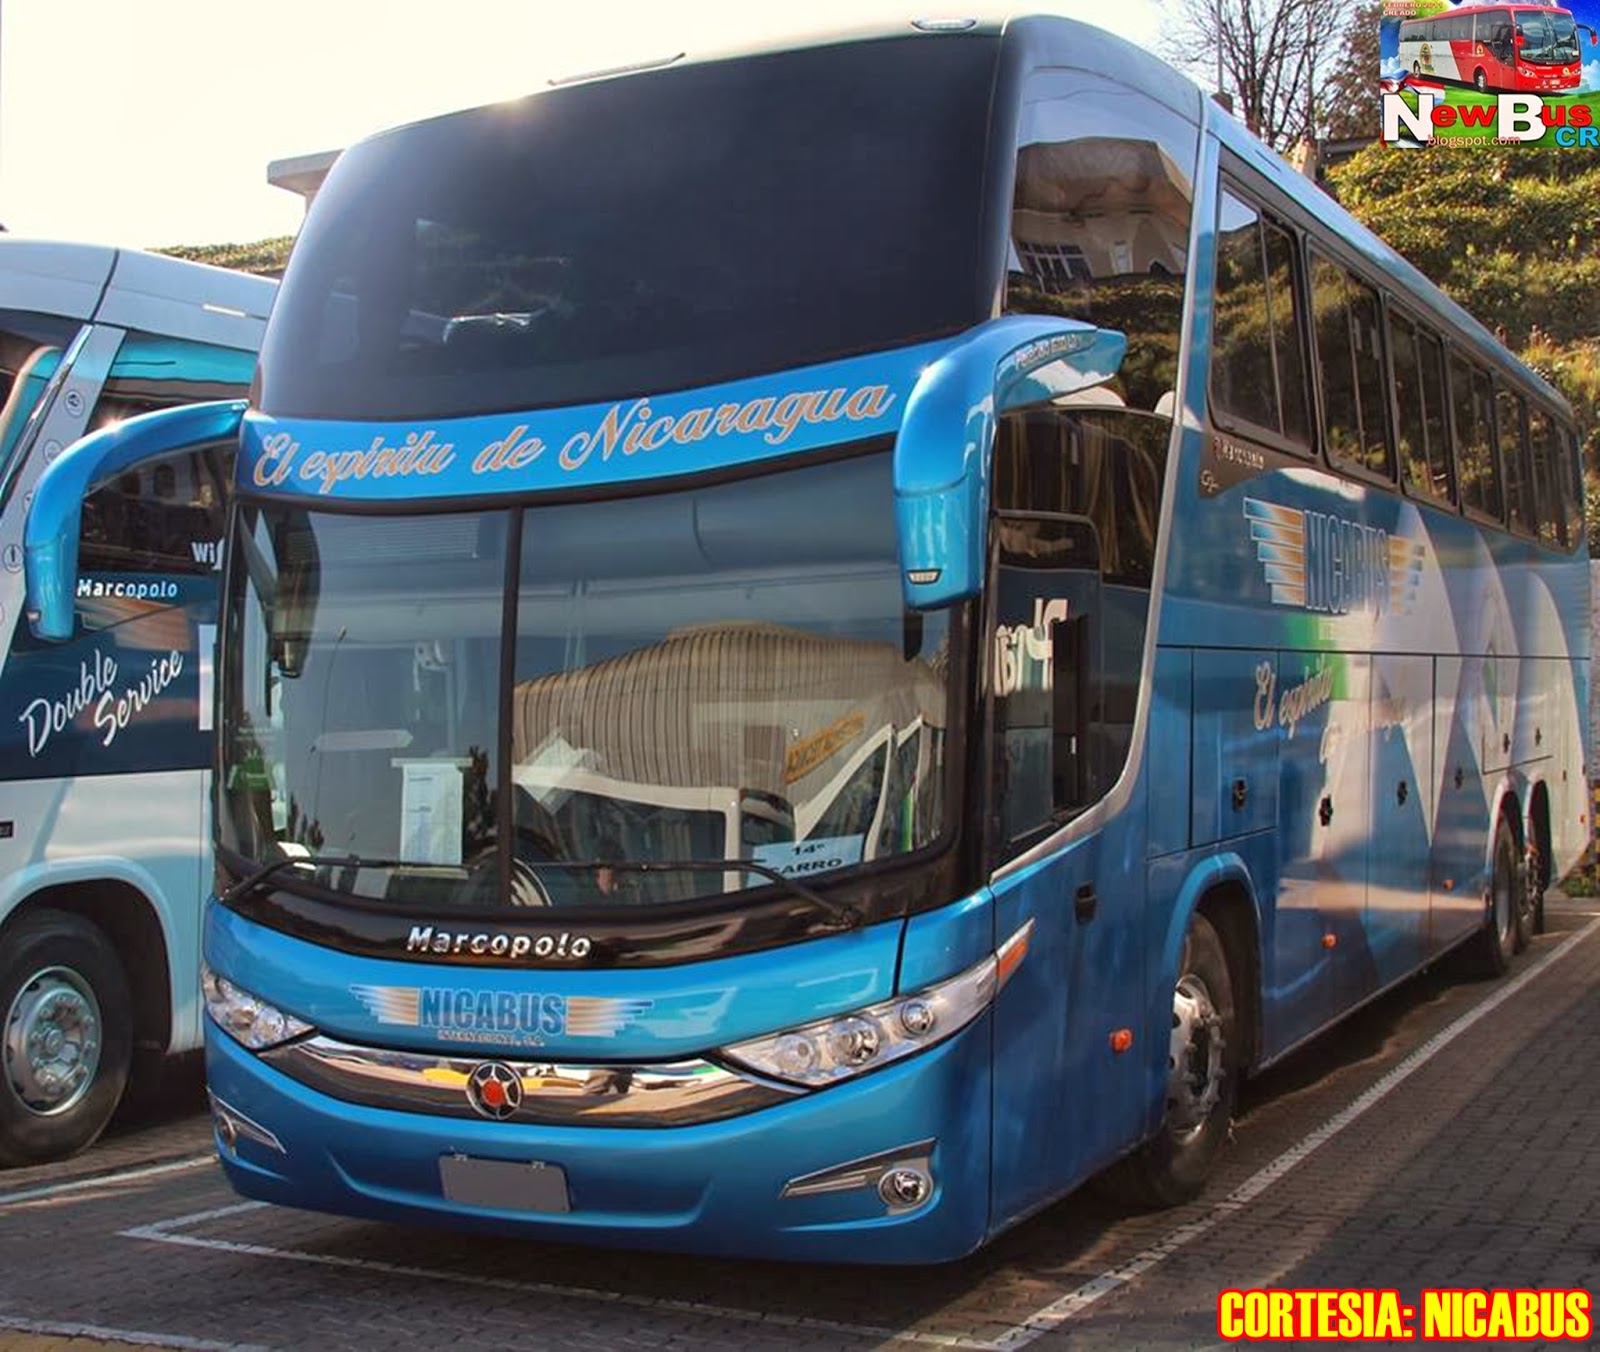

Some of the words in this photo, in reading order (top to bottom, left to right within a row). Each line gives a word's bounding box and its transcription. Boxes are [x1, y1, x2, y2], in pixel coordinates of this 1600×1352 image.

[254, 433, 299, 486] El
[472, 425, 546, 474] de
[559, 384, 896, 471] Nicaragua
[77, 579, 178, 599] Marcopolo
[19, 649, 118, 757] Double
[94, 650, 183, 746] Service
[407, 926, 591, 958] Marcopolo
[420, 987, 567, 1035] NICABUS
